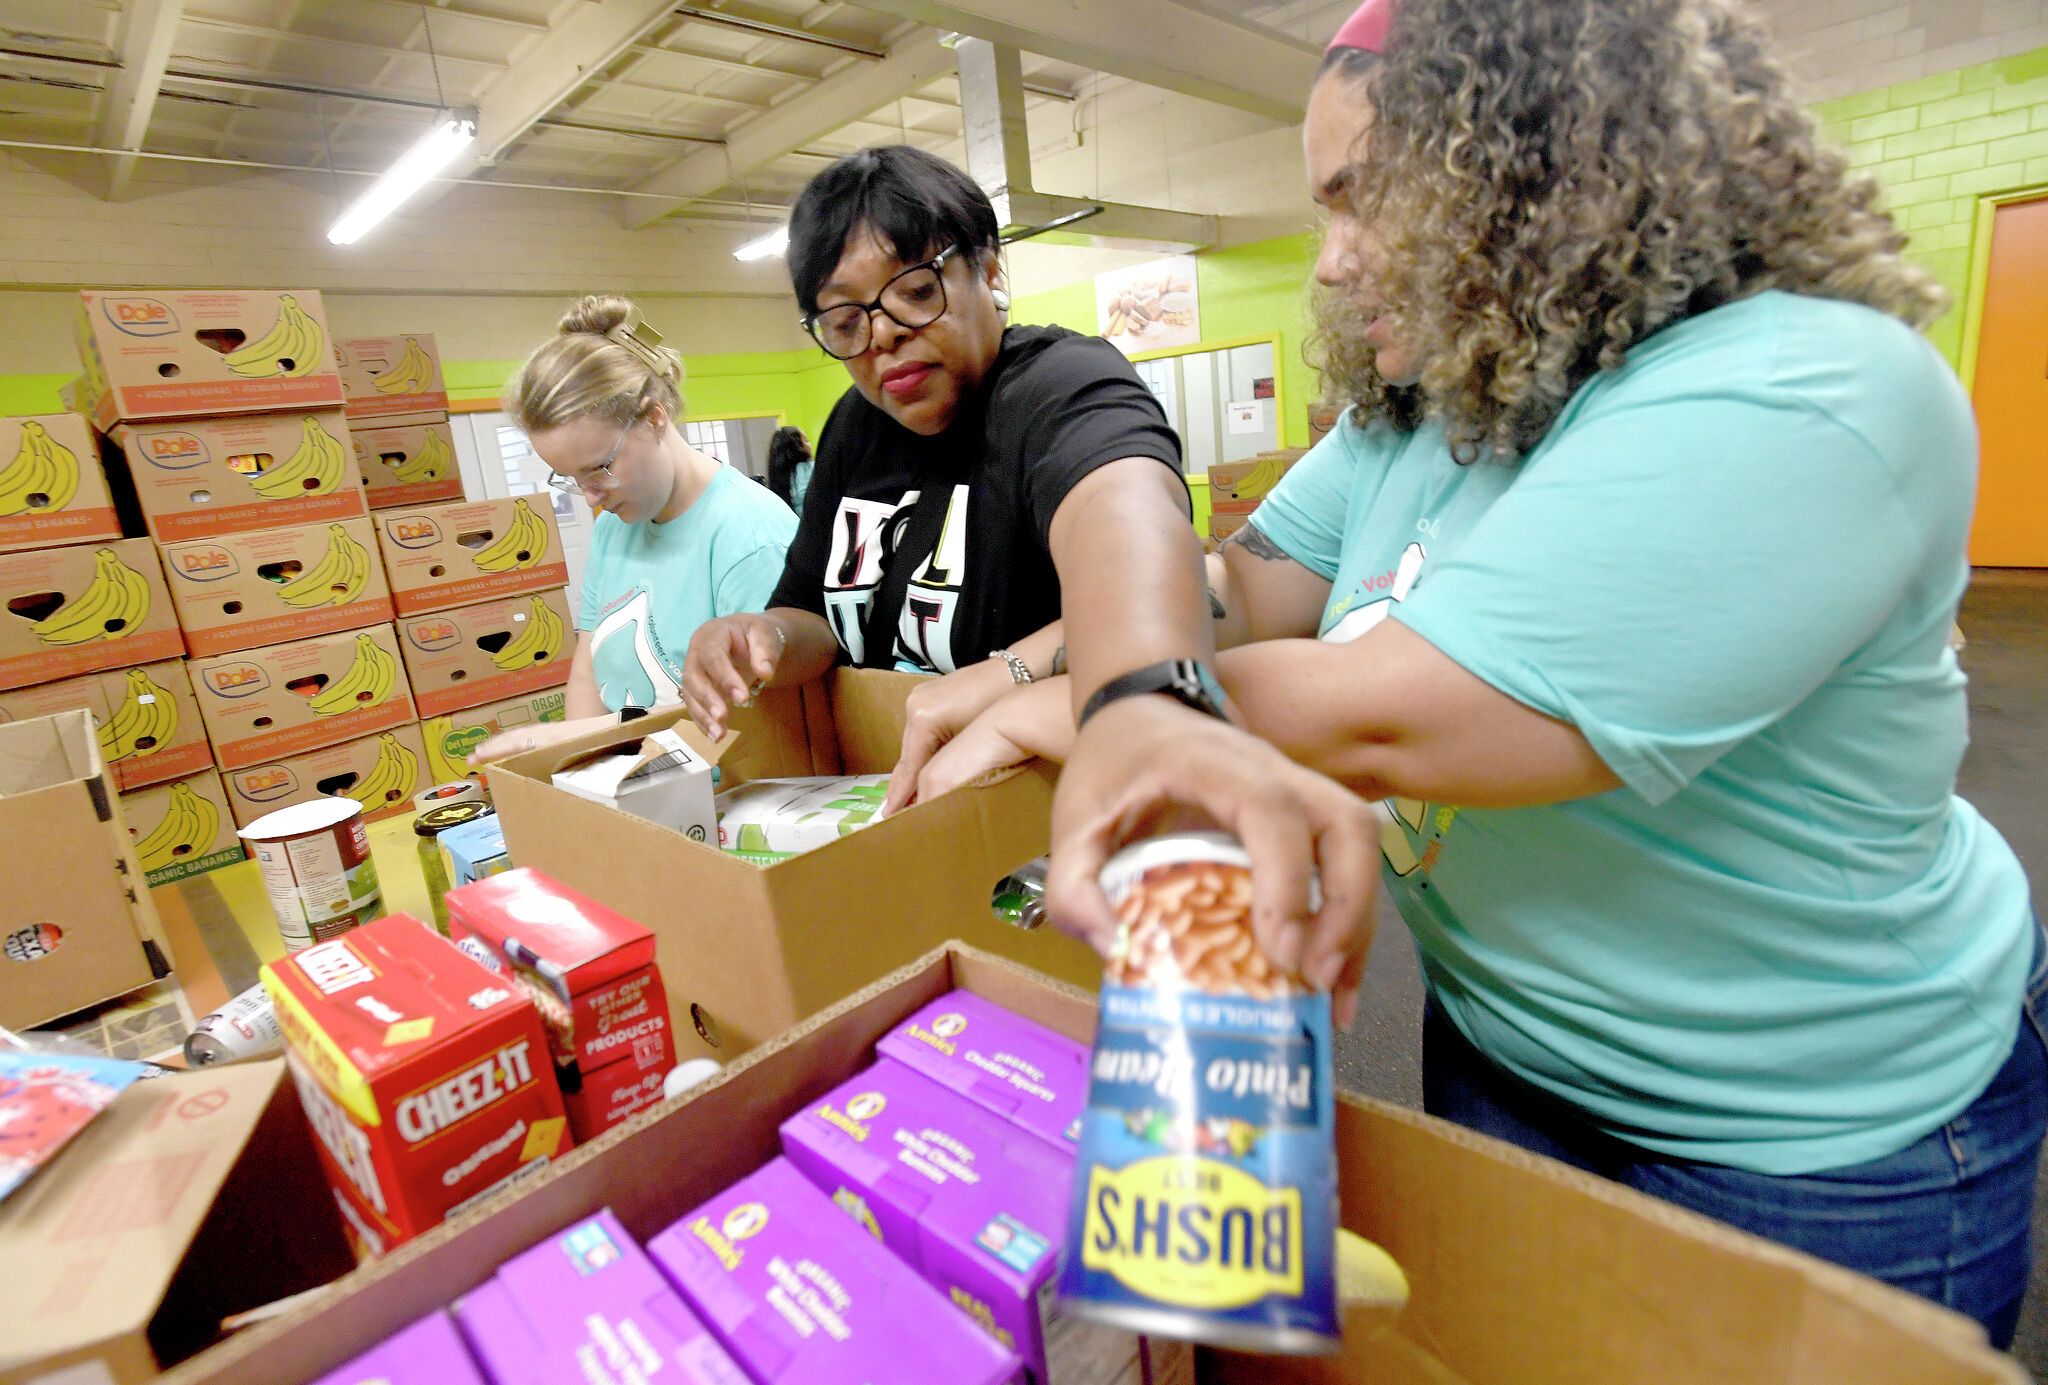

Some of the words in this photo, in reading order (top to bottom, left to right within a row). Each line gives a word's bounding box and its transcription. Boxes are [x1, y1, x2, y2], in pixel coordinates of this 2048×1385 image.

[117, 304, 167, 322] Dole
[151, 437, 200, 455] Dole
[396, 522, 434, 538] Dole
[182, 550, 230, 570] Dole
[416, 623, 454, 641] Dole
[215, 667, 260, 687] Dole
[245, 770, 288, 790] Dole
[186, 849, 239, 873] BANANAS
[585, 1015, 665, 1056] PRODUCTS
[1205, 1056, 1312, 1109] Pinto
[1095, 1185, 1290, 1276] BUSH'S
